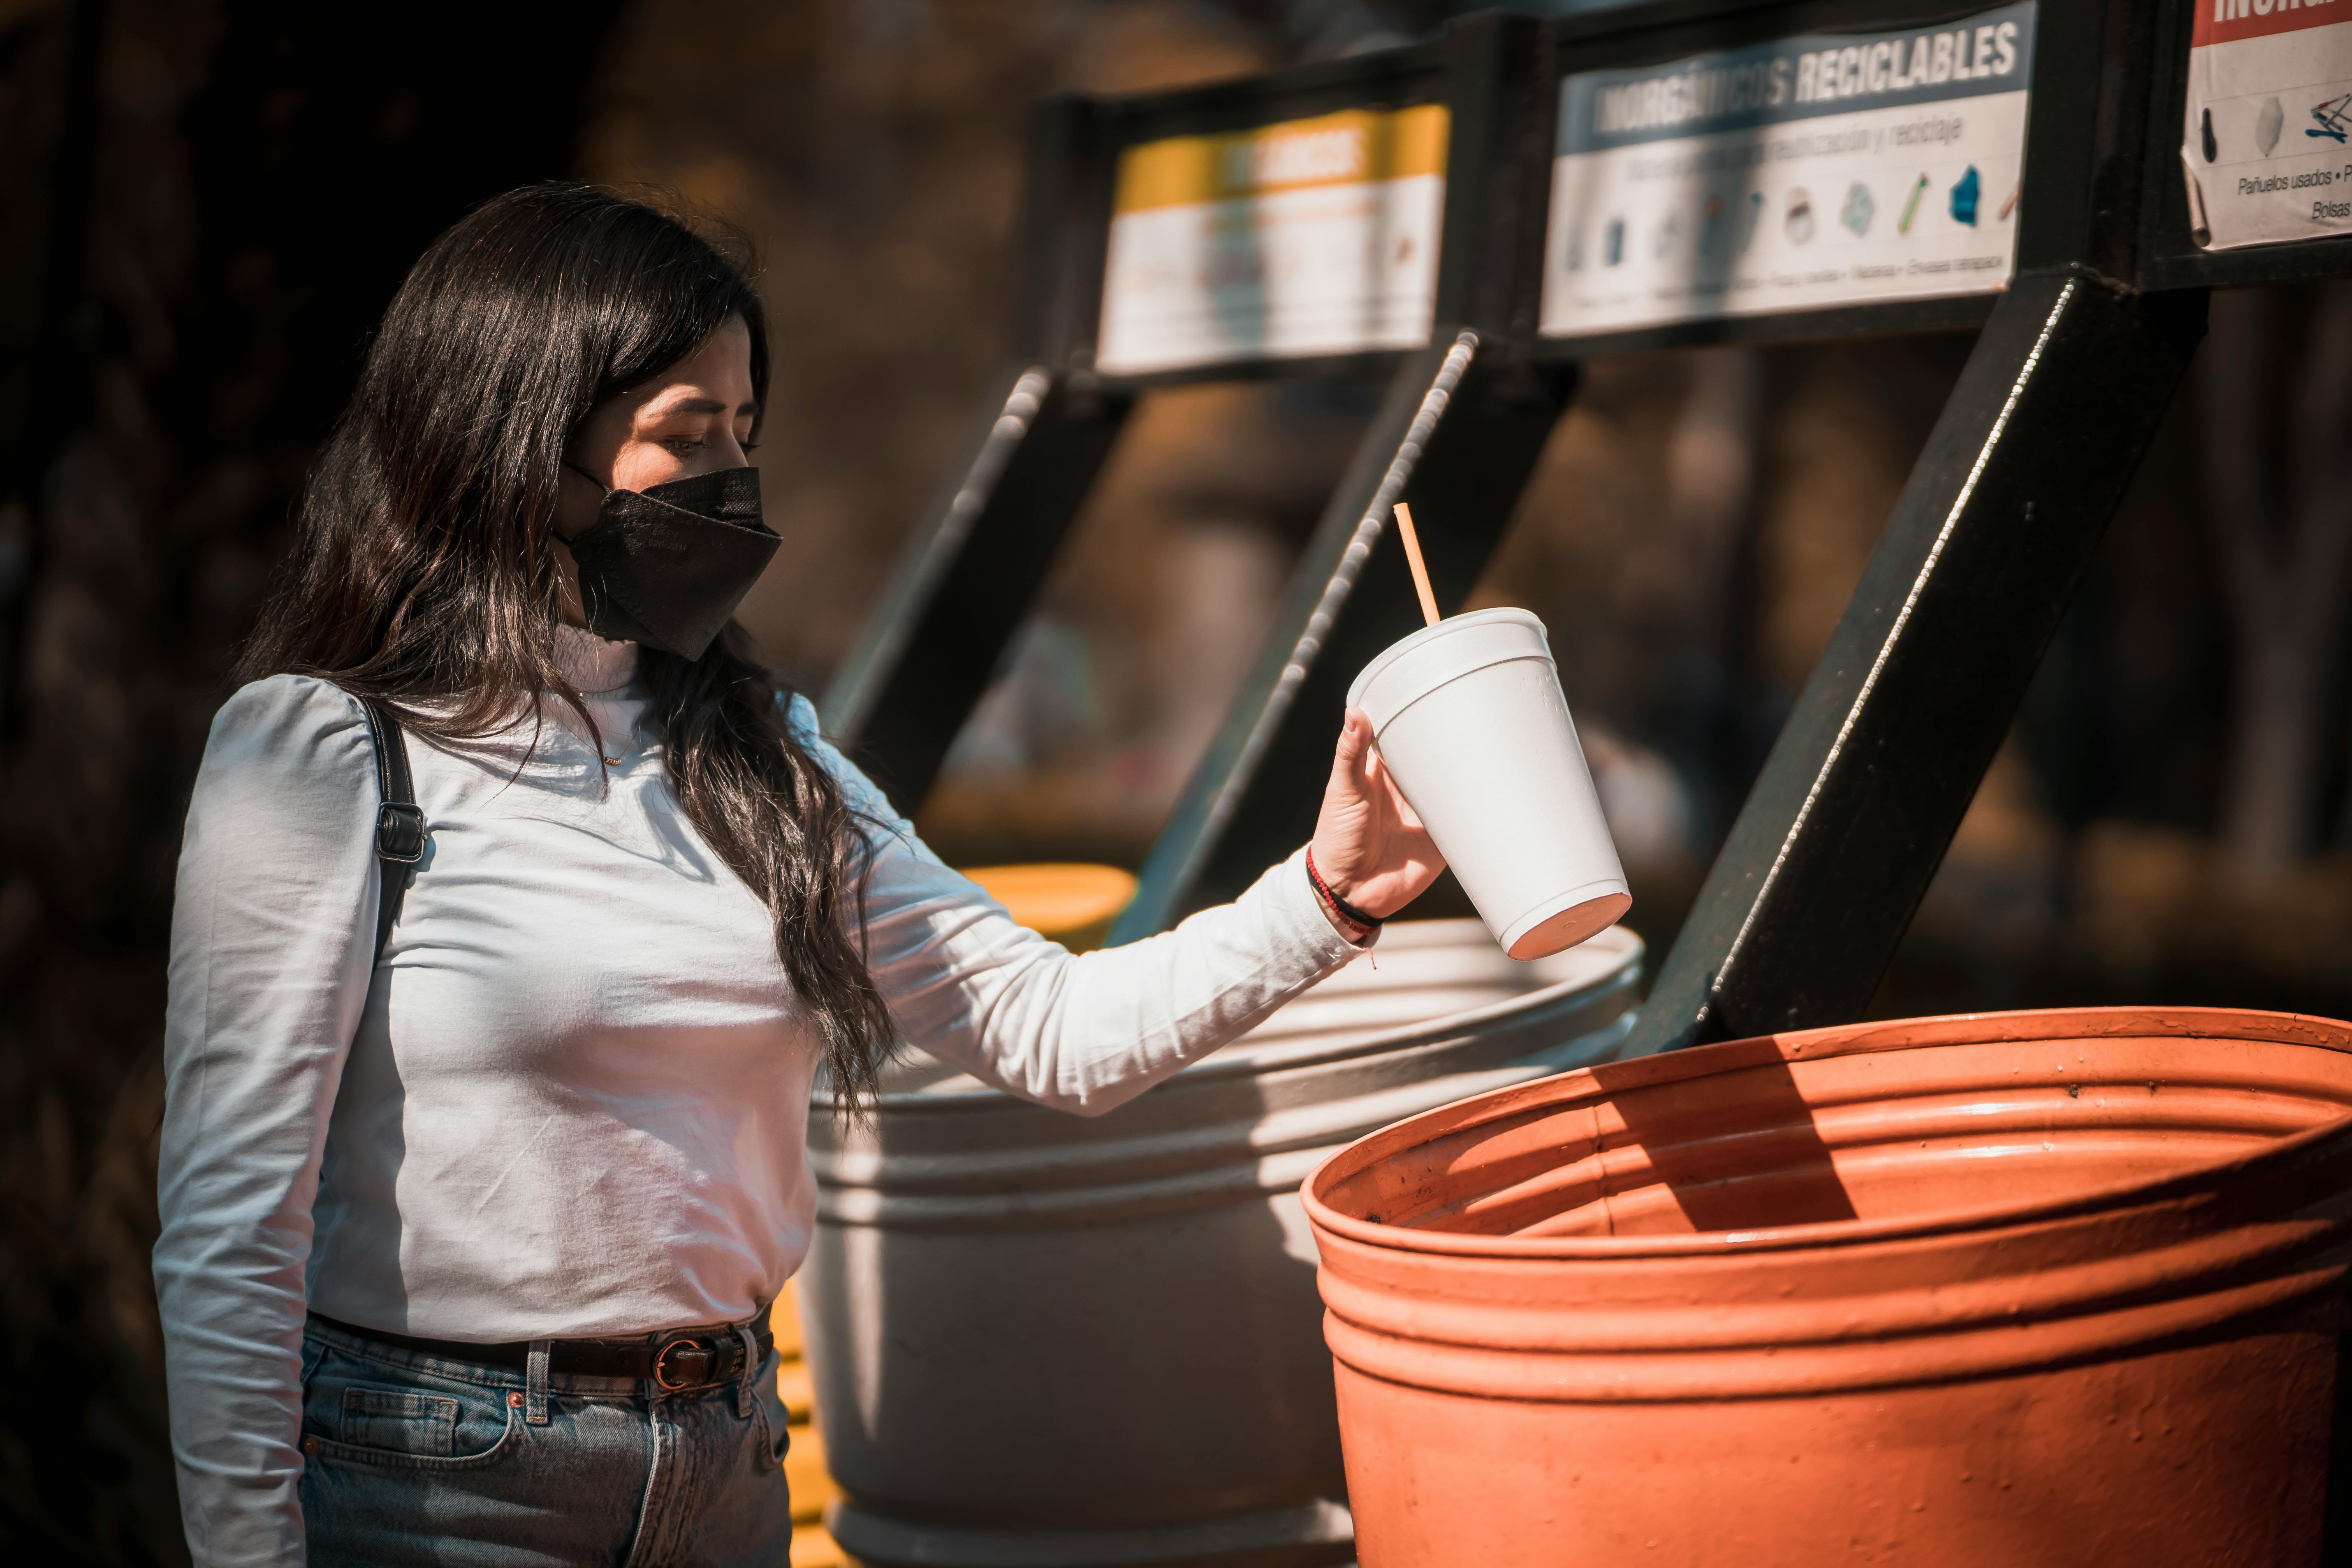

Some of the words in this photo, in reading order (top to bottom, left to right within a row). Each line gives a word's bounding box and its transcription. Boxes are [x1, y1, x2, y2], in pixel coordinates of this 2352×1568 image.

[1795, 21, 2019, 102] RECICLABLES
[1889, 115, 1963, 146] reciclaje
[2238, 174, 2289, 196] Pañuelos
[2291, 169, 2332, 189] usados
[2312, 200, 2350, 219] Bolsas
